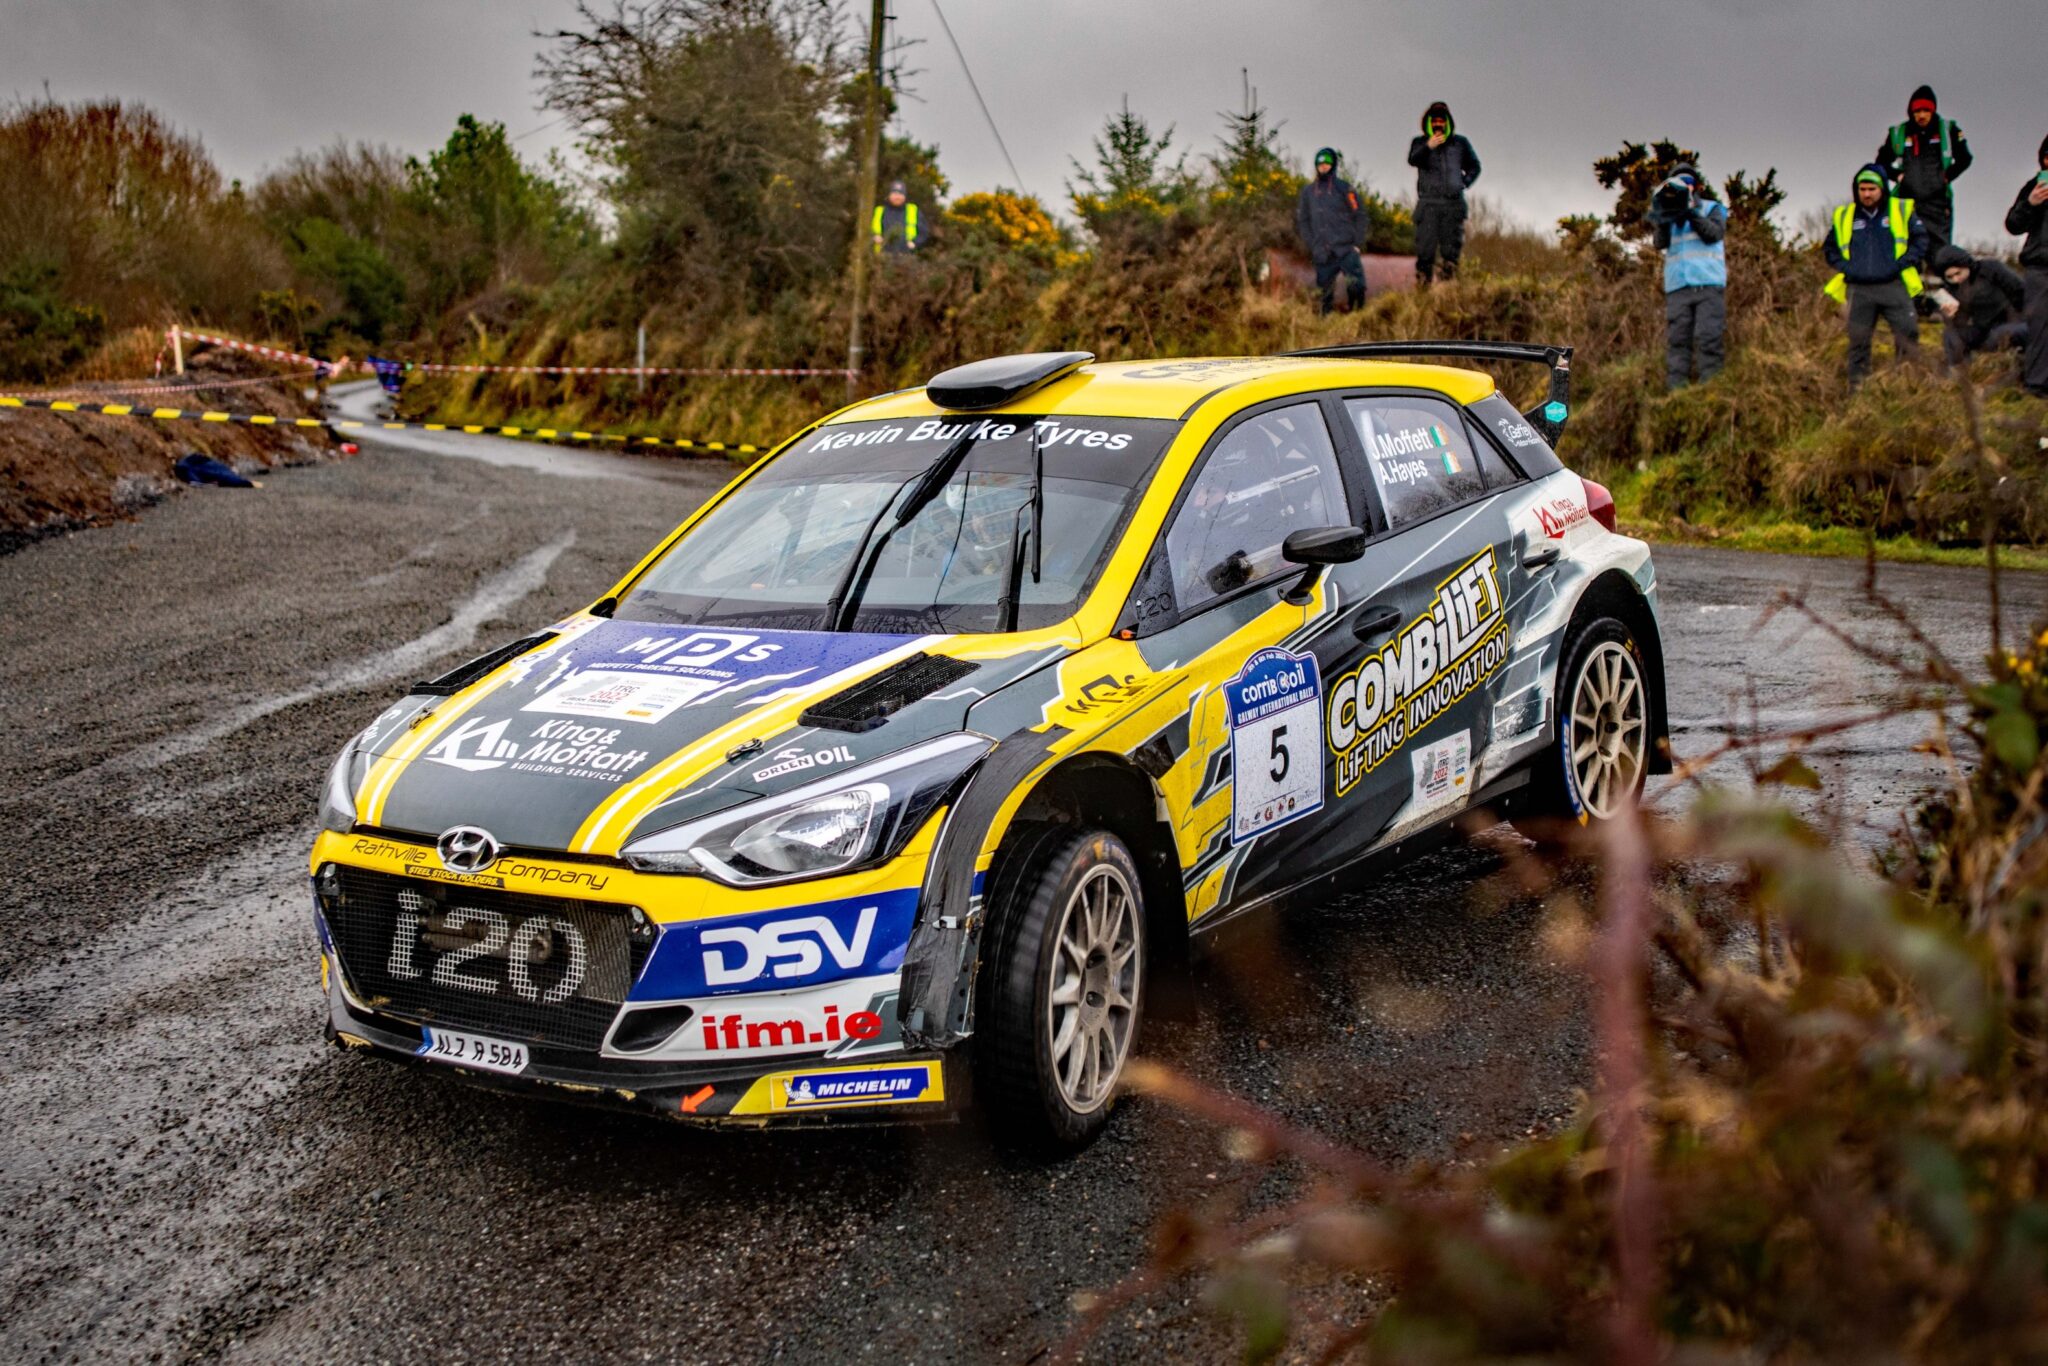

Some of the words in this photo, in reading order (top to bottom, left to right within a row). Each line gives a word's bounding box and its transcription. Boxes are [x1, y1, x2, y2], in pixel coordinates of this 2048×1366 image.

[808, 424, 904, 454] Kevin
[1026, 420, 1133, 450] Tyres
[1371, 427, 1434, 460] J.Moffett
[1379, 459, 1428, 486] A.Hayes
[675, 665, 737, 678] SOLUTIONS
[1409, 629, 1506, 731] INNOVATION
[518, 740, 650, 773] Moffatt
[757, 757, 811, 779] ORLEN
[814, 745, 857, 766] OIL
[1269, 724, 1290, 783] 5
[510, 761, 564, 775] BUILDING
[566, 768, 624, 784] SERVICES
[350, 838, 428, 864] Rathville
[495, 858, 610, 891] Company
[408, 866, 431, 877] STEEL
[432, 868, 458, 881] STOCK
[387, 887, 587, 1003] i20
[699, 906, 879, 986] DSV
[701, 1004, 883, 1051] ifm.ie
[433, 1033, 465, 1057] ALZ
[816, 1077, 912, 1097] MICHELIN
